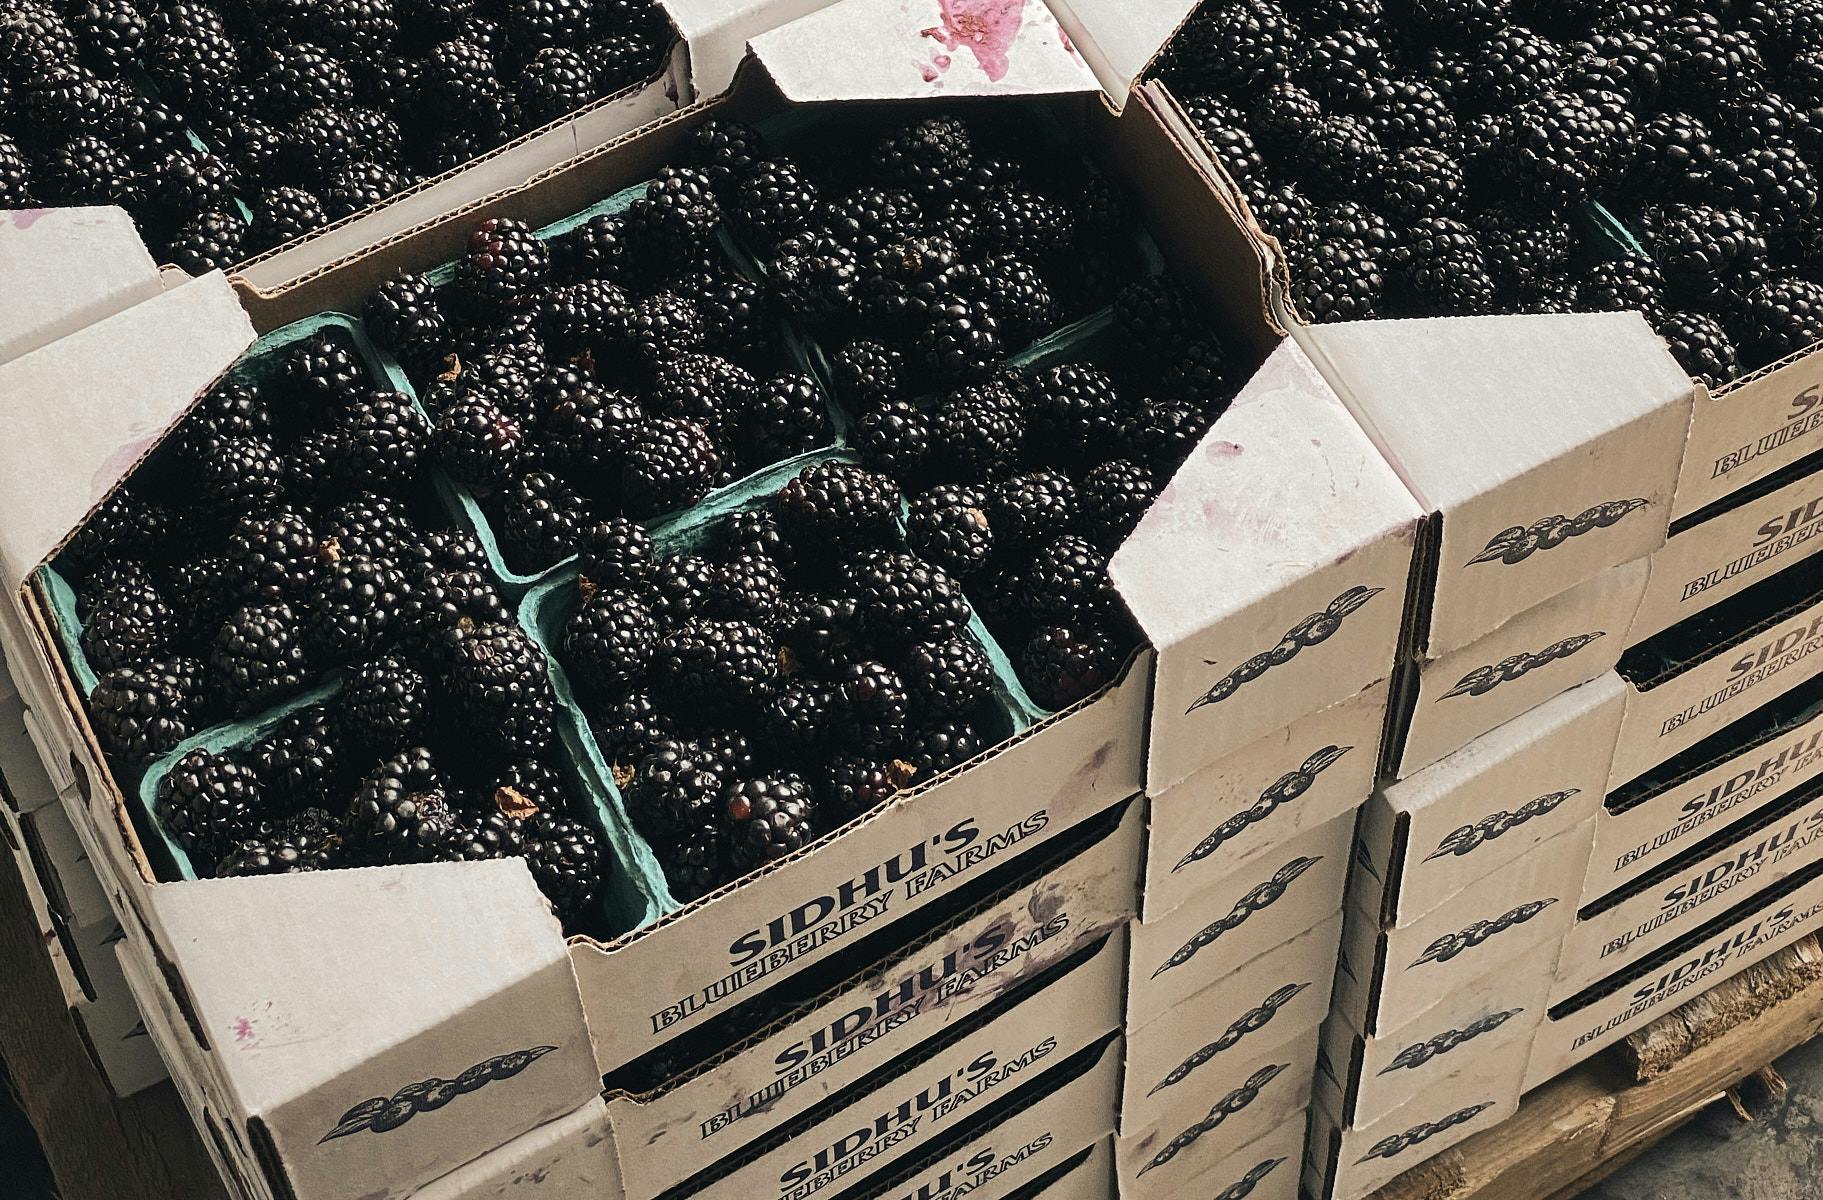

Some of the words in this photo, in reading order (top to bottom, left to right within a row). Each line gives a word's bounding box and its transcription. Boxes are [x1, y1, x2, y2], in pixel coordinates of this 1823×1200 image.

[1659, 634, 1823, 737] BLUEBERR
[1614, 765, 1790, 872] BLUEBERRY
[650, 889, 895, 1035] BLUEBERRY
[905, 810, 1050, 900] FARMS
[729, 817, 979, 966] SIDHU'S
[1600, 856, 1769, 959] BLUEBERRY
[774, 923, 1006, 1076] SIDHU'S
[1571, 952, 1733, 1051] BLUEBERRY
[1629, 903, 1794, 1007] SIDHU'S
[700, 996, 926, 1140] BLUEBERRY
[936, 912, 1070, 1006] FARMS
[780, 1050, 998, 1193] SIDHU'S
[931, 1036, 1057, 1124] FARMS
